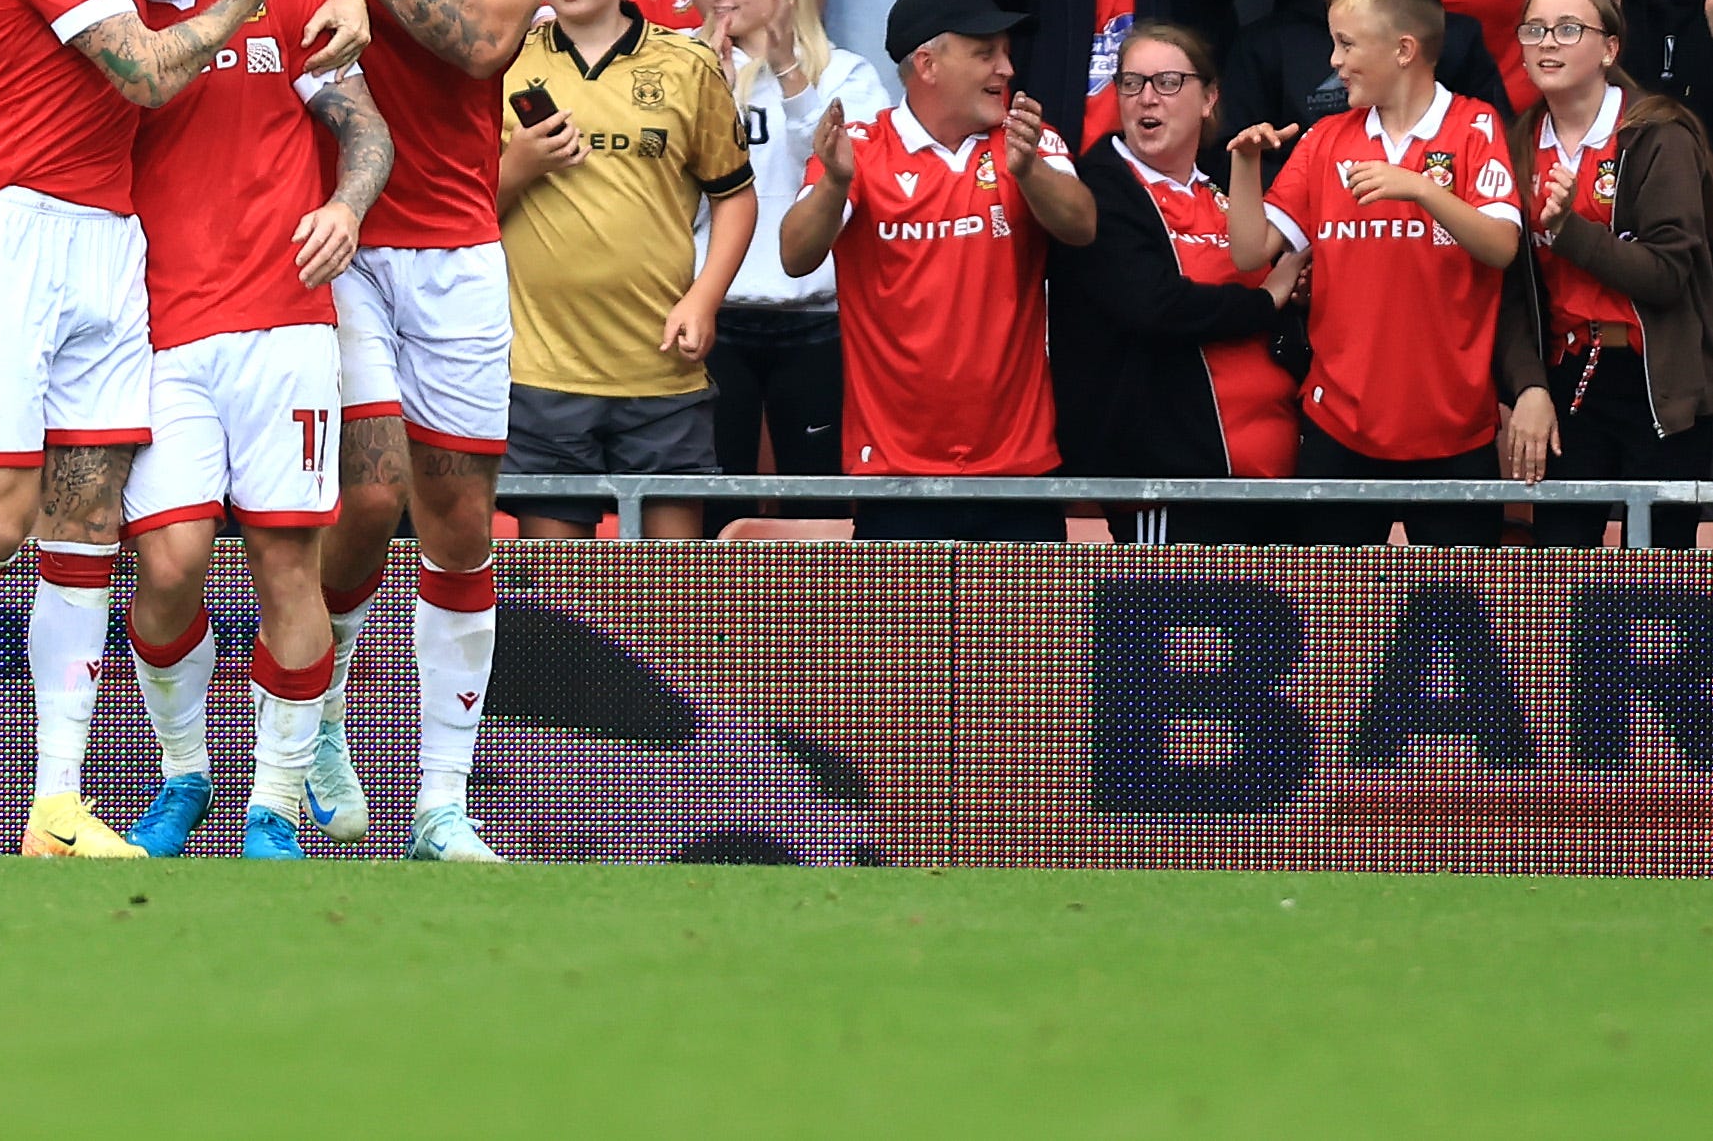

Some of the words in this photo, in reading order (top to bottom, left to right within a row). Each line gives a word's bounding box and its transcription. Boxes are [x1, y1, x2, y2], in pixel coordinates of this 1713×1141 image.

[1477, 159, 1514, 198] hp
[878, 218, 983, 242] UNITED
[1318, 219, 1425, 244] UNITED
[292, 409, 329, 472] 11
